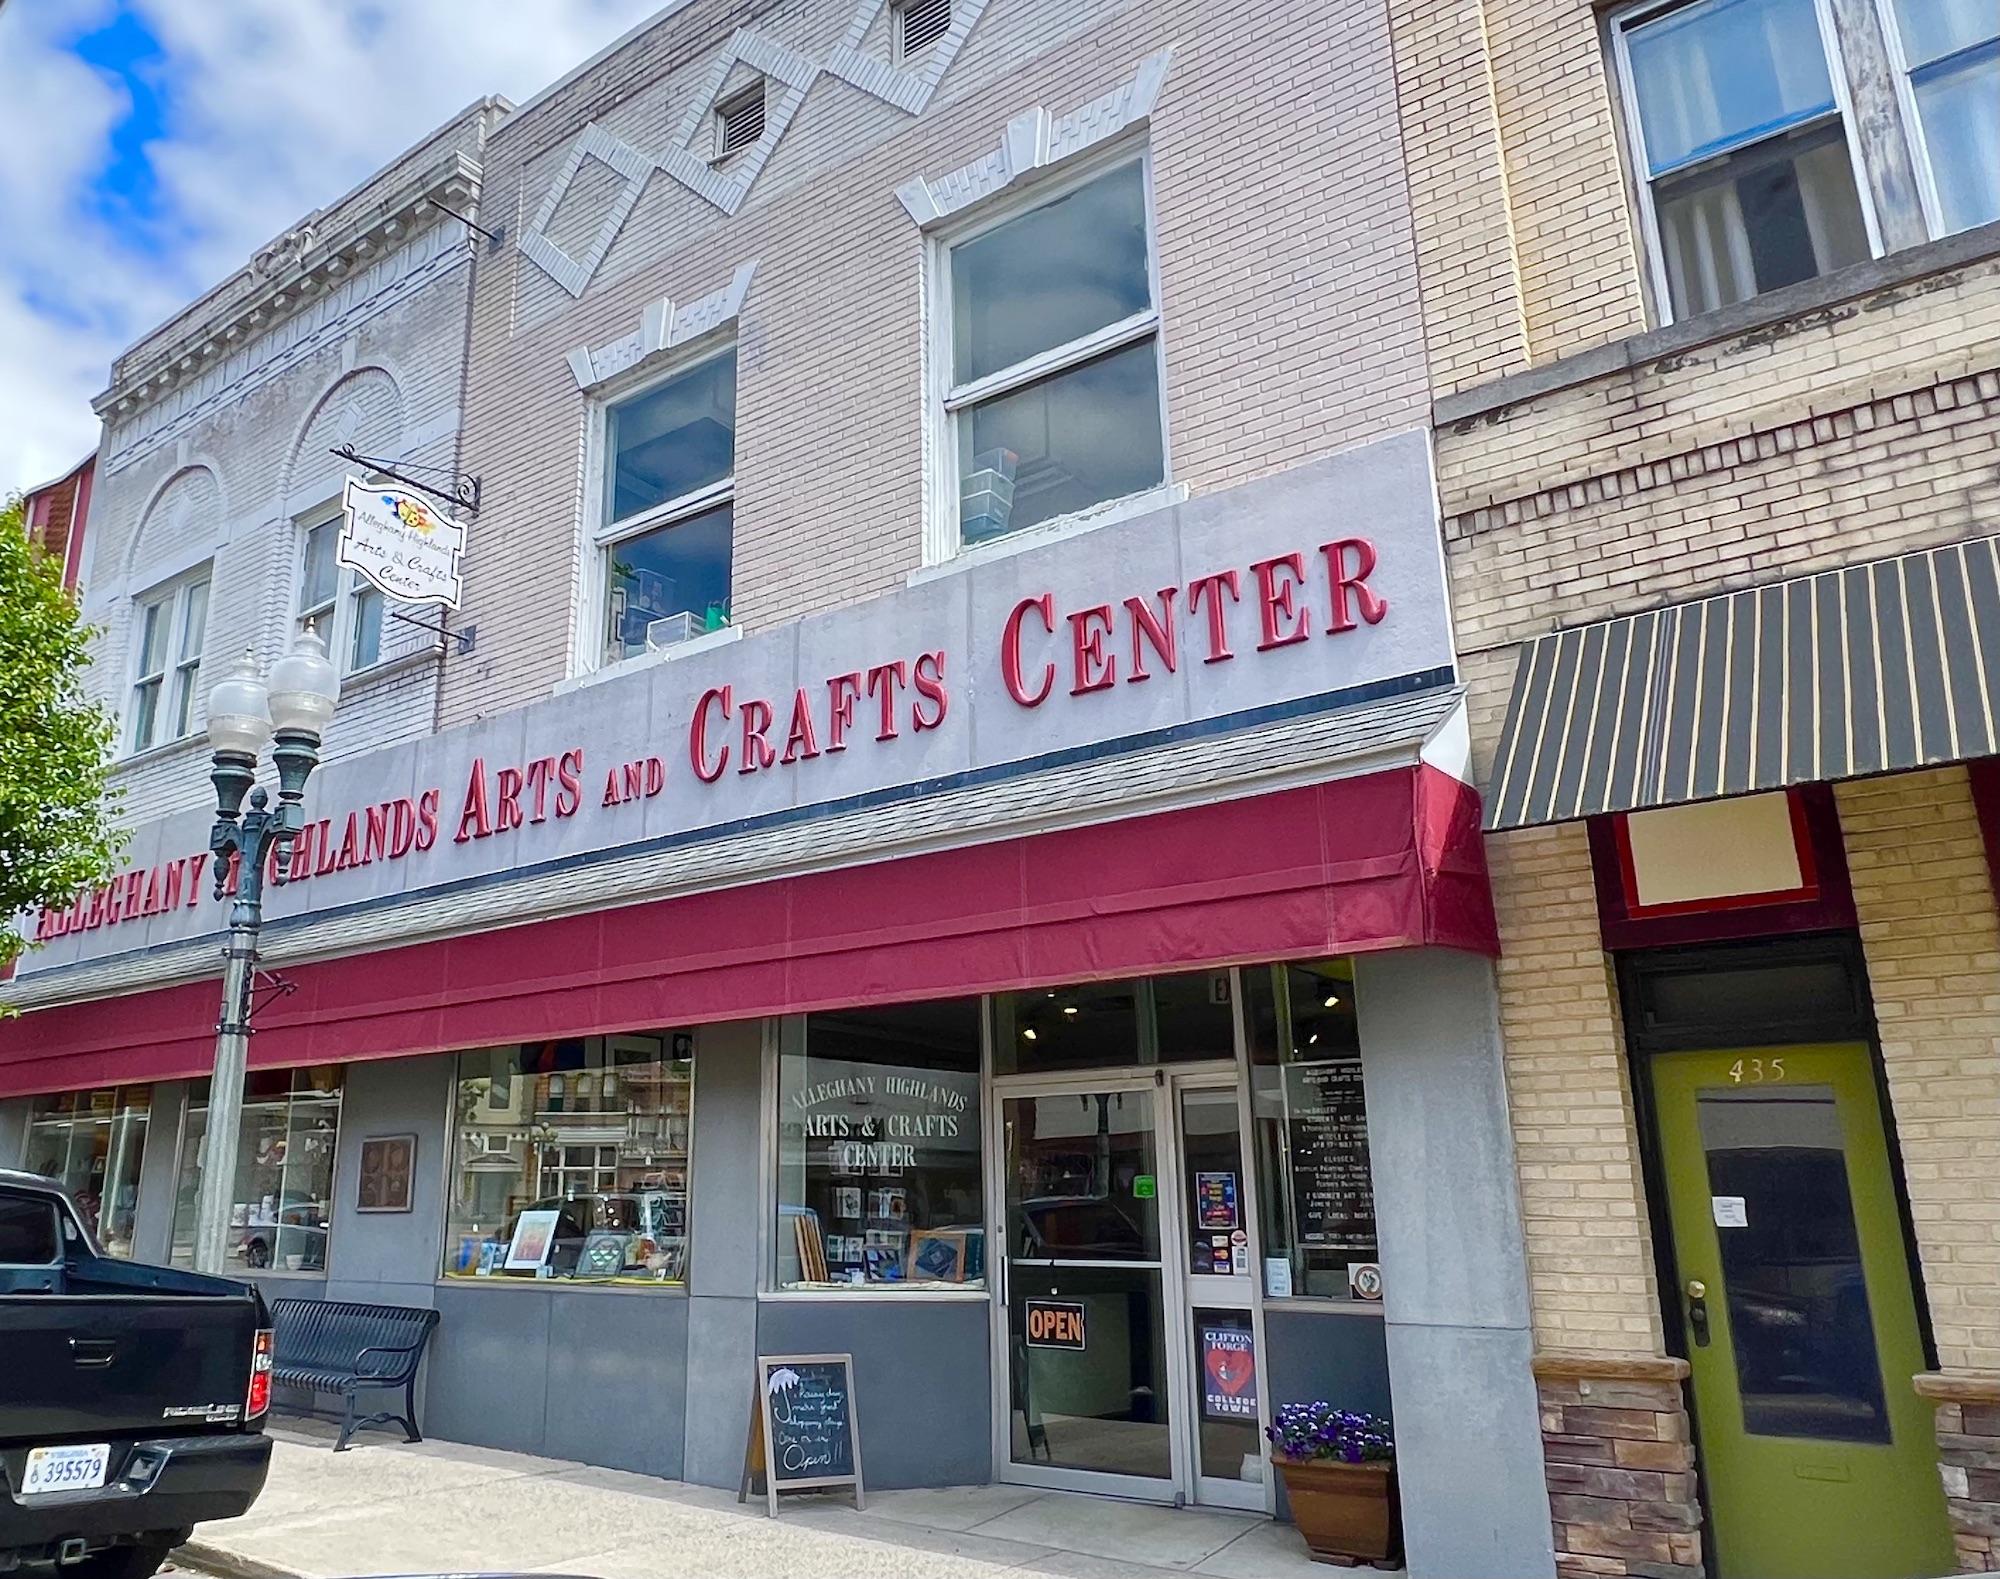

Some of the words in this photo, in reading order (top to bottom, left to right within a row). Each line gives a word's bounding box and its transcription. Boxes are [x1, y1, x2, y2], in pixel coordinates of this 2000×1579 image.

[353, 537, 387, 559] Arts
[407, 556, 448, 582] Crafts
[379, 566, 420, 591] Center
[453, 748, 583, 844] ARTS
[601, 756, 666, 808] AND
[688, 651, 949, 784] CRAFTS
[1001, 537, 1387, 708] CENTER
[1729, 1058, 1785, 1083] 435
[791, 1076, 877, 1111] ALLEGHANY
[886, 1077, 969, 1113] HIGHLANDS
[802, 1114, 850, 1137] ARTS
[861, 1115, 876, 1137] &
[888, 1115, 959, 1137] CRAFTS
[844, 1144, 917, 1167] CENTER
[1030, 1309, 1081, 1341] OPEN
[1205, 1331, 1252, 1344] CLIFTON
[1212, 1341, 1248, 1352] FORGE
[1207, 1394, 1256, 1406] COLLEGE
[1215, 1403, 1250, 1414] TOWN
[44, 1458, 102, 1483] 395579
